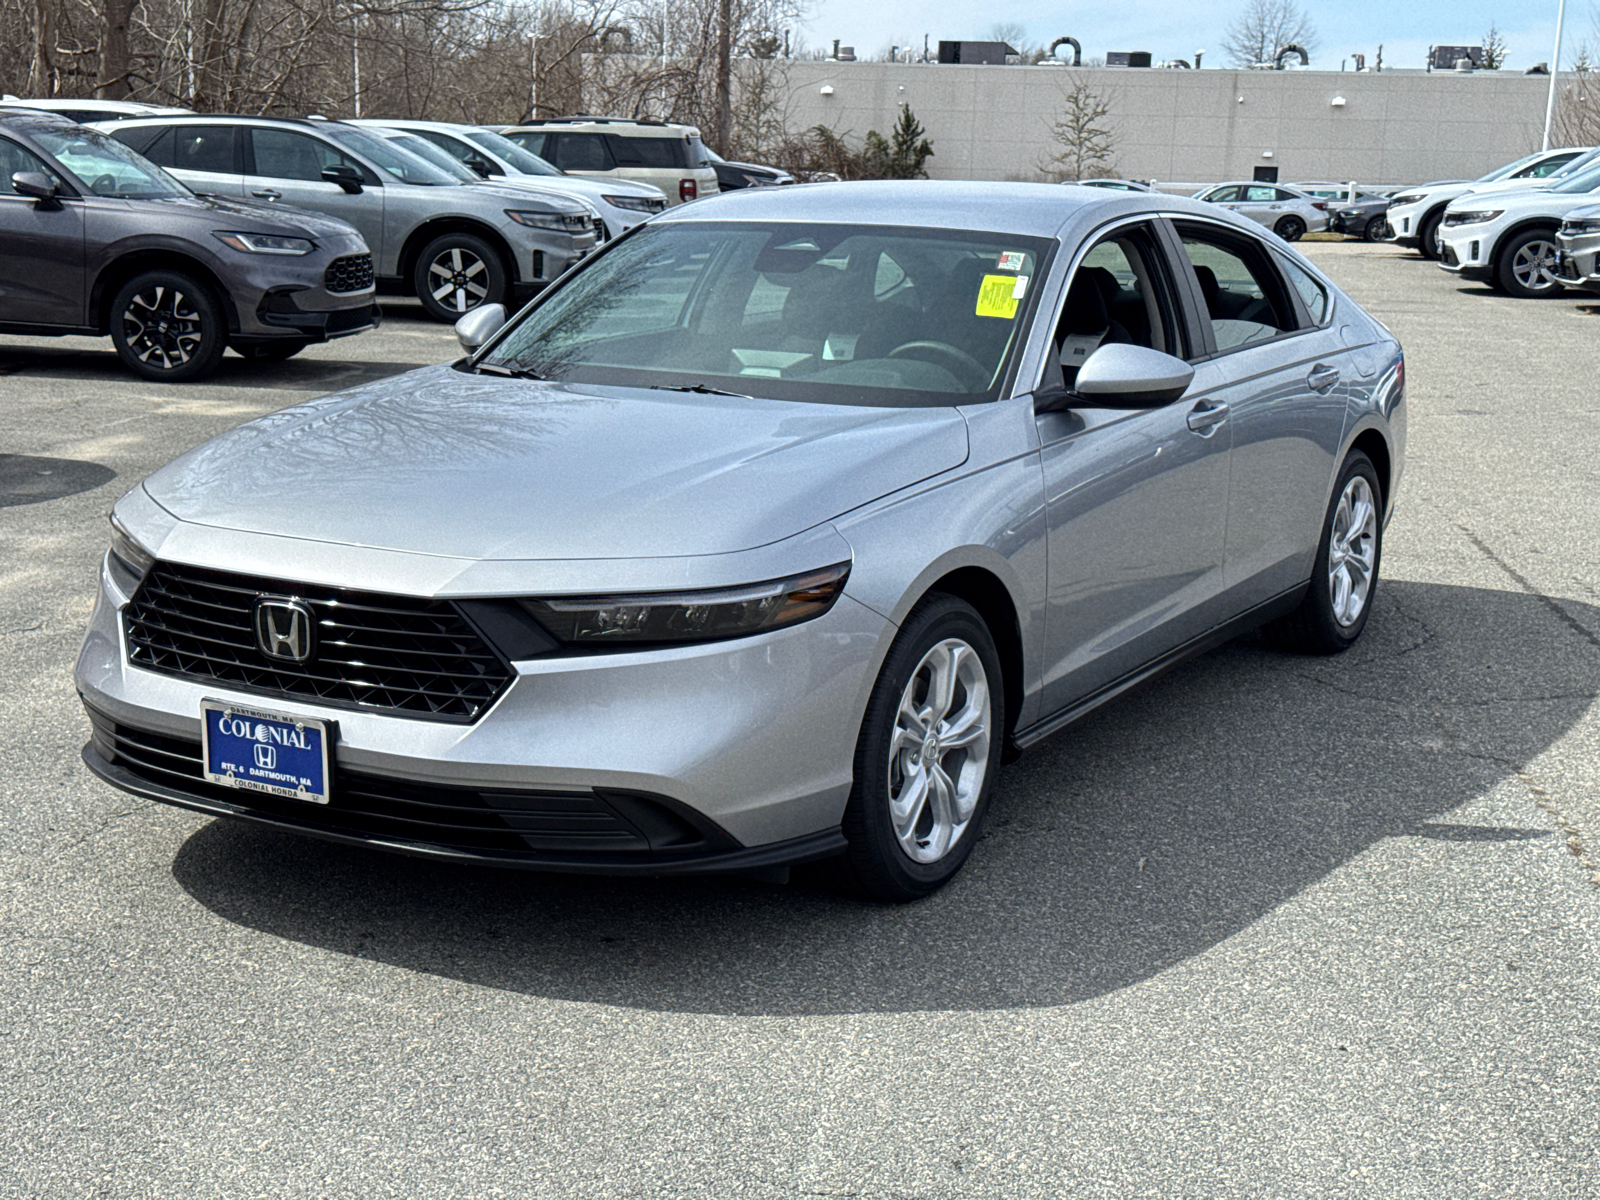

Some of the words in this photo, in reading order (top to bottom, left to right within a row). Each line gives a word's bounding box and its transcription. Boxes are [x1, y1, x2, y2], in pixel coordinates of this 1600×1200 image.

[219, 717, 311, 750] COLONIAL
[221, 762, 238, 772] RTE.
[250, 768, 298, 784] DARTMOUTH,
[300, 778, 312, 786] MA
[234, 779, 270, 792] COLONIAL
[271, 786, 298, 798] HONDA
